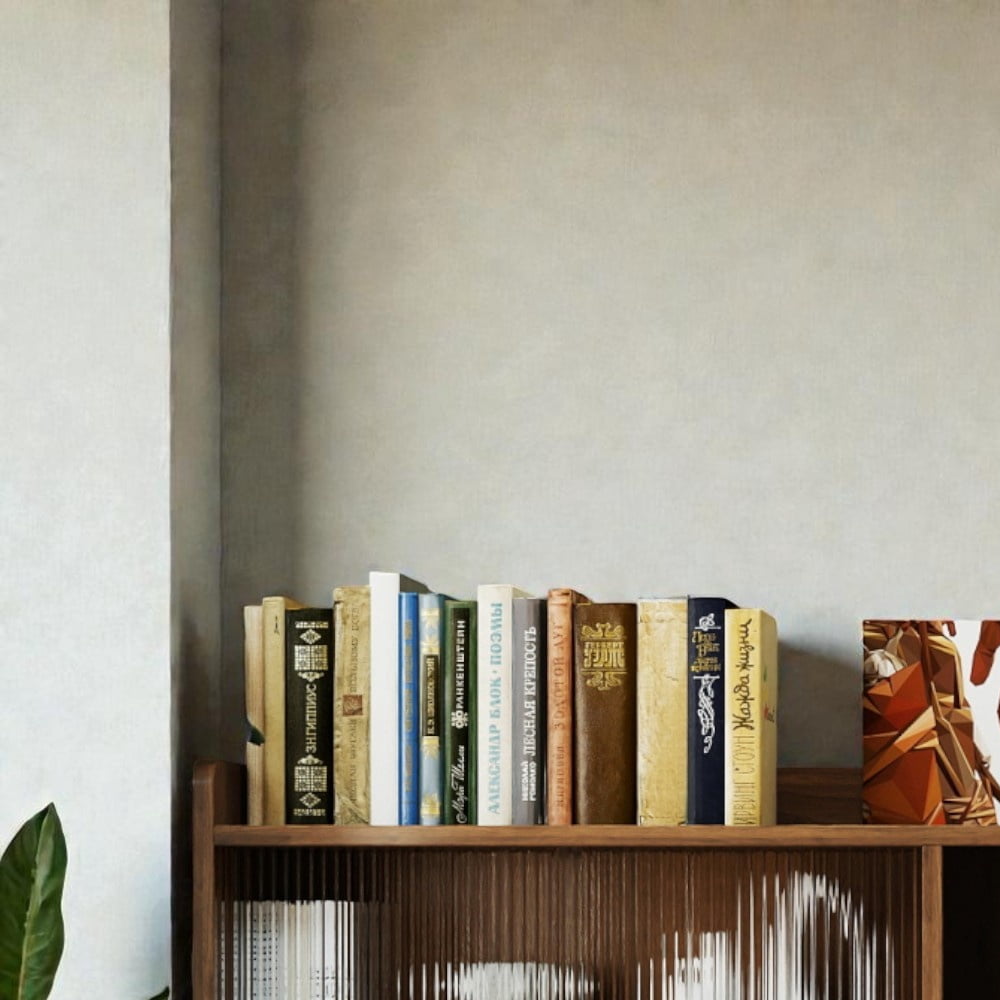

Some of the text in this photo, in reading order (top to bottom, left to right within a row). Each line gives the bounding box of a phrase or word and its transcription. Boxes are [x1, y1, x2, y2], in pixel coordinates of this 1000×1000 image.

[488, 602, 503, 815] АЛЕКСАНДР БЛОК ПОЭМЫ
[523, 626, 537, 756] ЛЕСНАЯ КРЕПОСТЬ
[732, 619, 755, 731] Жажда жизни
[733, 735, 756, 825] ИРВИНГ СТОУН
